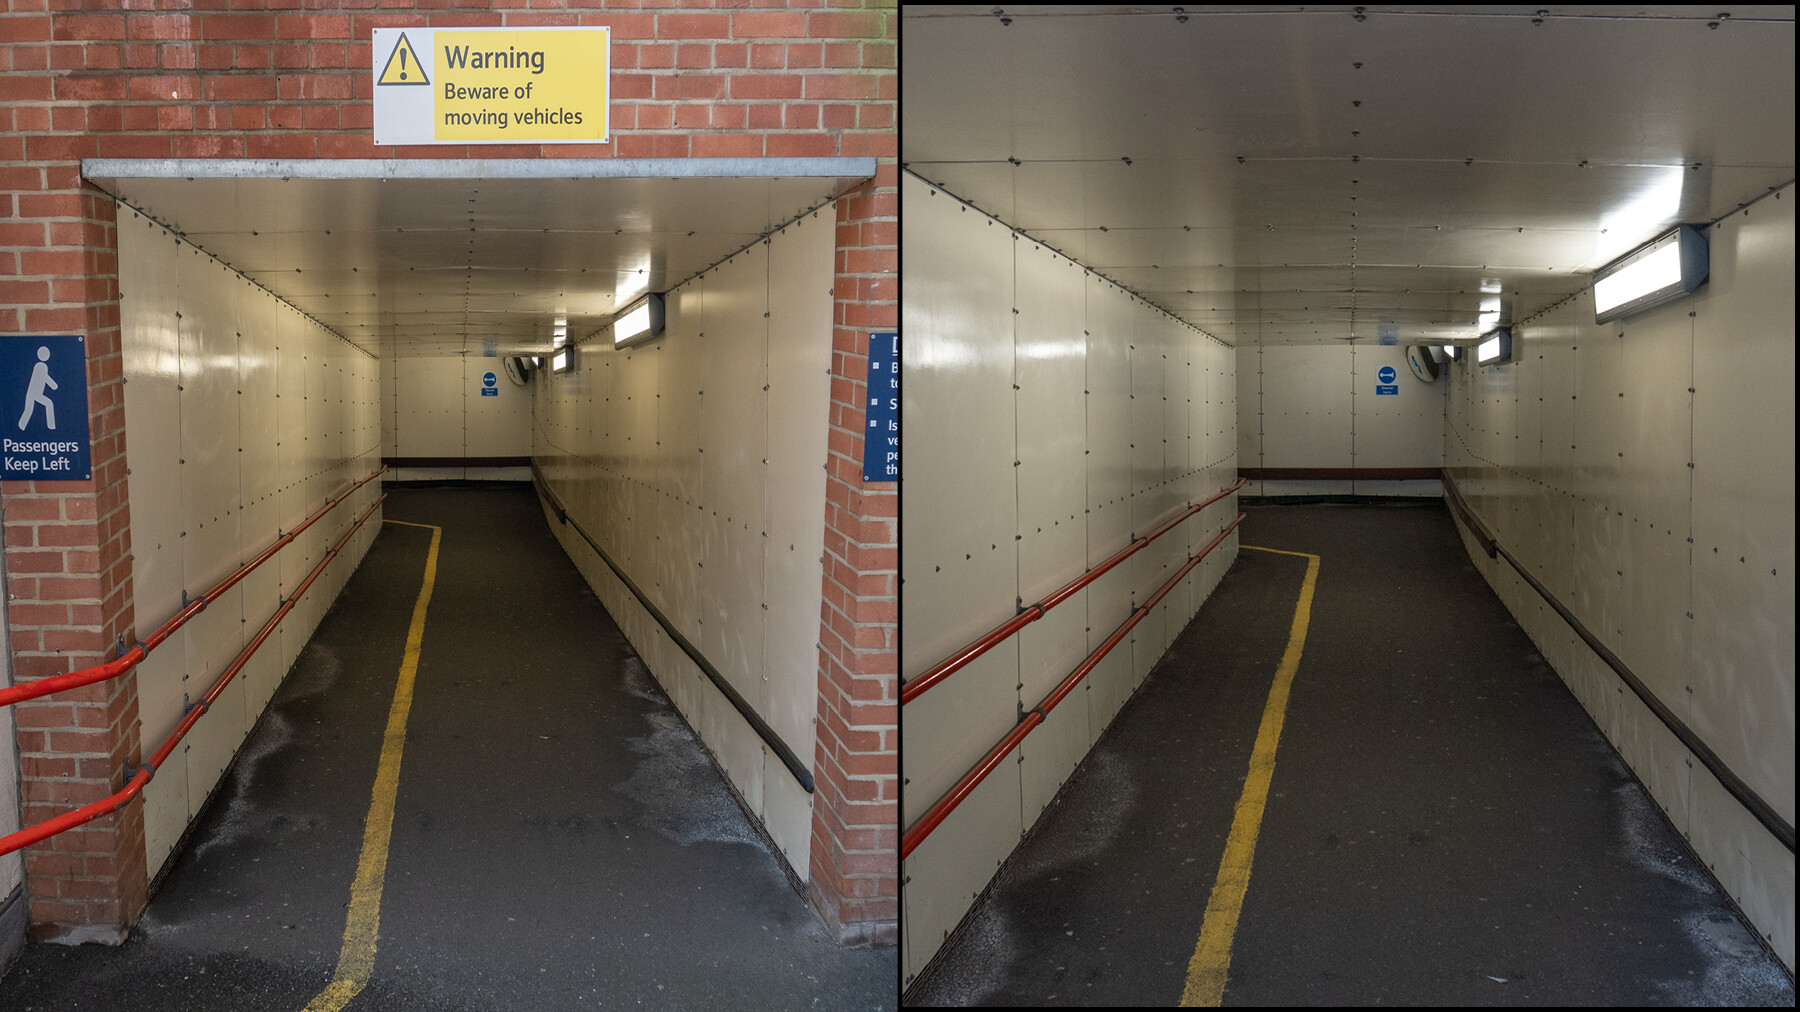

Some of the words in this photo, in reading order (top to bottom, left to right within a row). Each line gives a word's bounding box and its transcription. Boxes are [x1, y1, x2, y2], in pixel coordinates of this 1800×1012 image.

[445, 46, 544, 74] Warning
[445, 83, 508, 99] Beware
[515, 82, 532, 99] of
[445, 109, 507, 129] moving
[514, 108, 582, 124] vehicles
[4, 439, 78, 455] Passengers
[5, 457, 38, 473] Keep
[43, 457, 70, 470] Left
